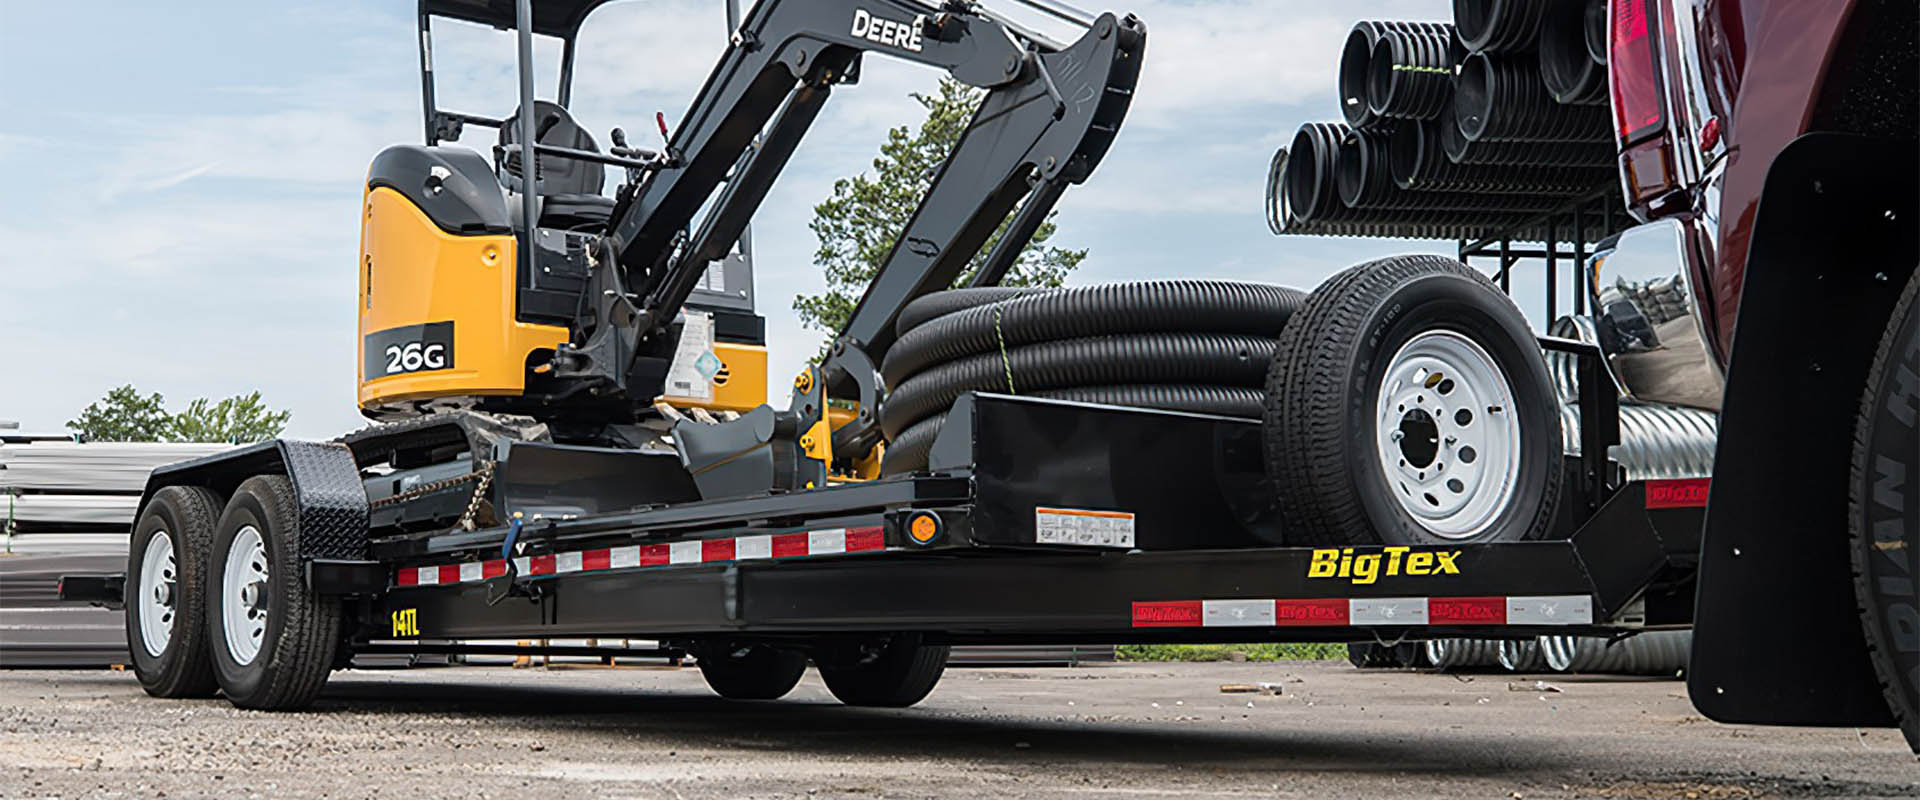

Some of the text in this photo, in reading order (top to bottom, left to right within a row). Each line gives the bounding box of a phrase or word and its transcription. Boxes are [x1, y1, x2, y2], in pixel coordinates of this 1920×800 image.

[851, 9, 922, 52] DEERE
[386, 342, 444, 373] 26G
[1308, 546, 1462, 585] BigTex
[392, 608, 420, 637] 14TL
